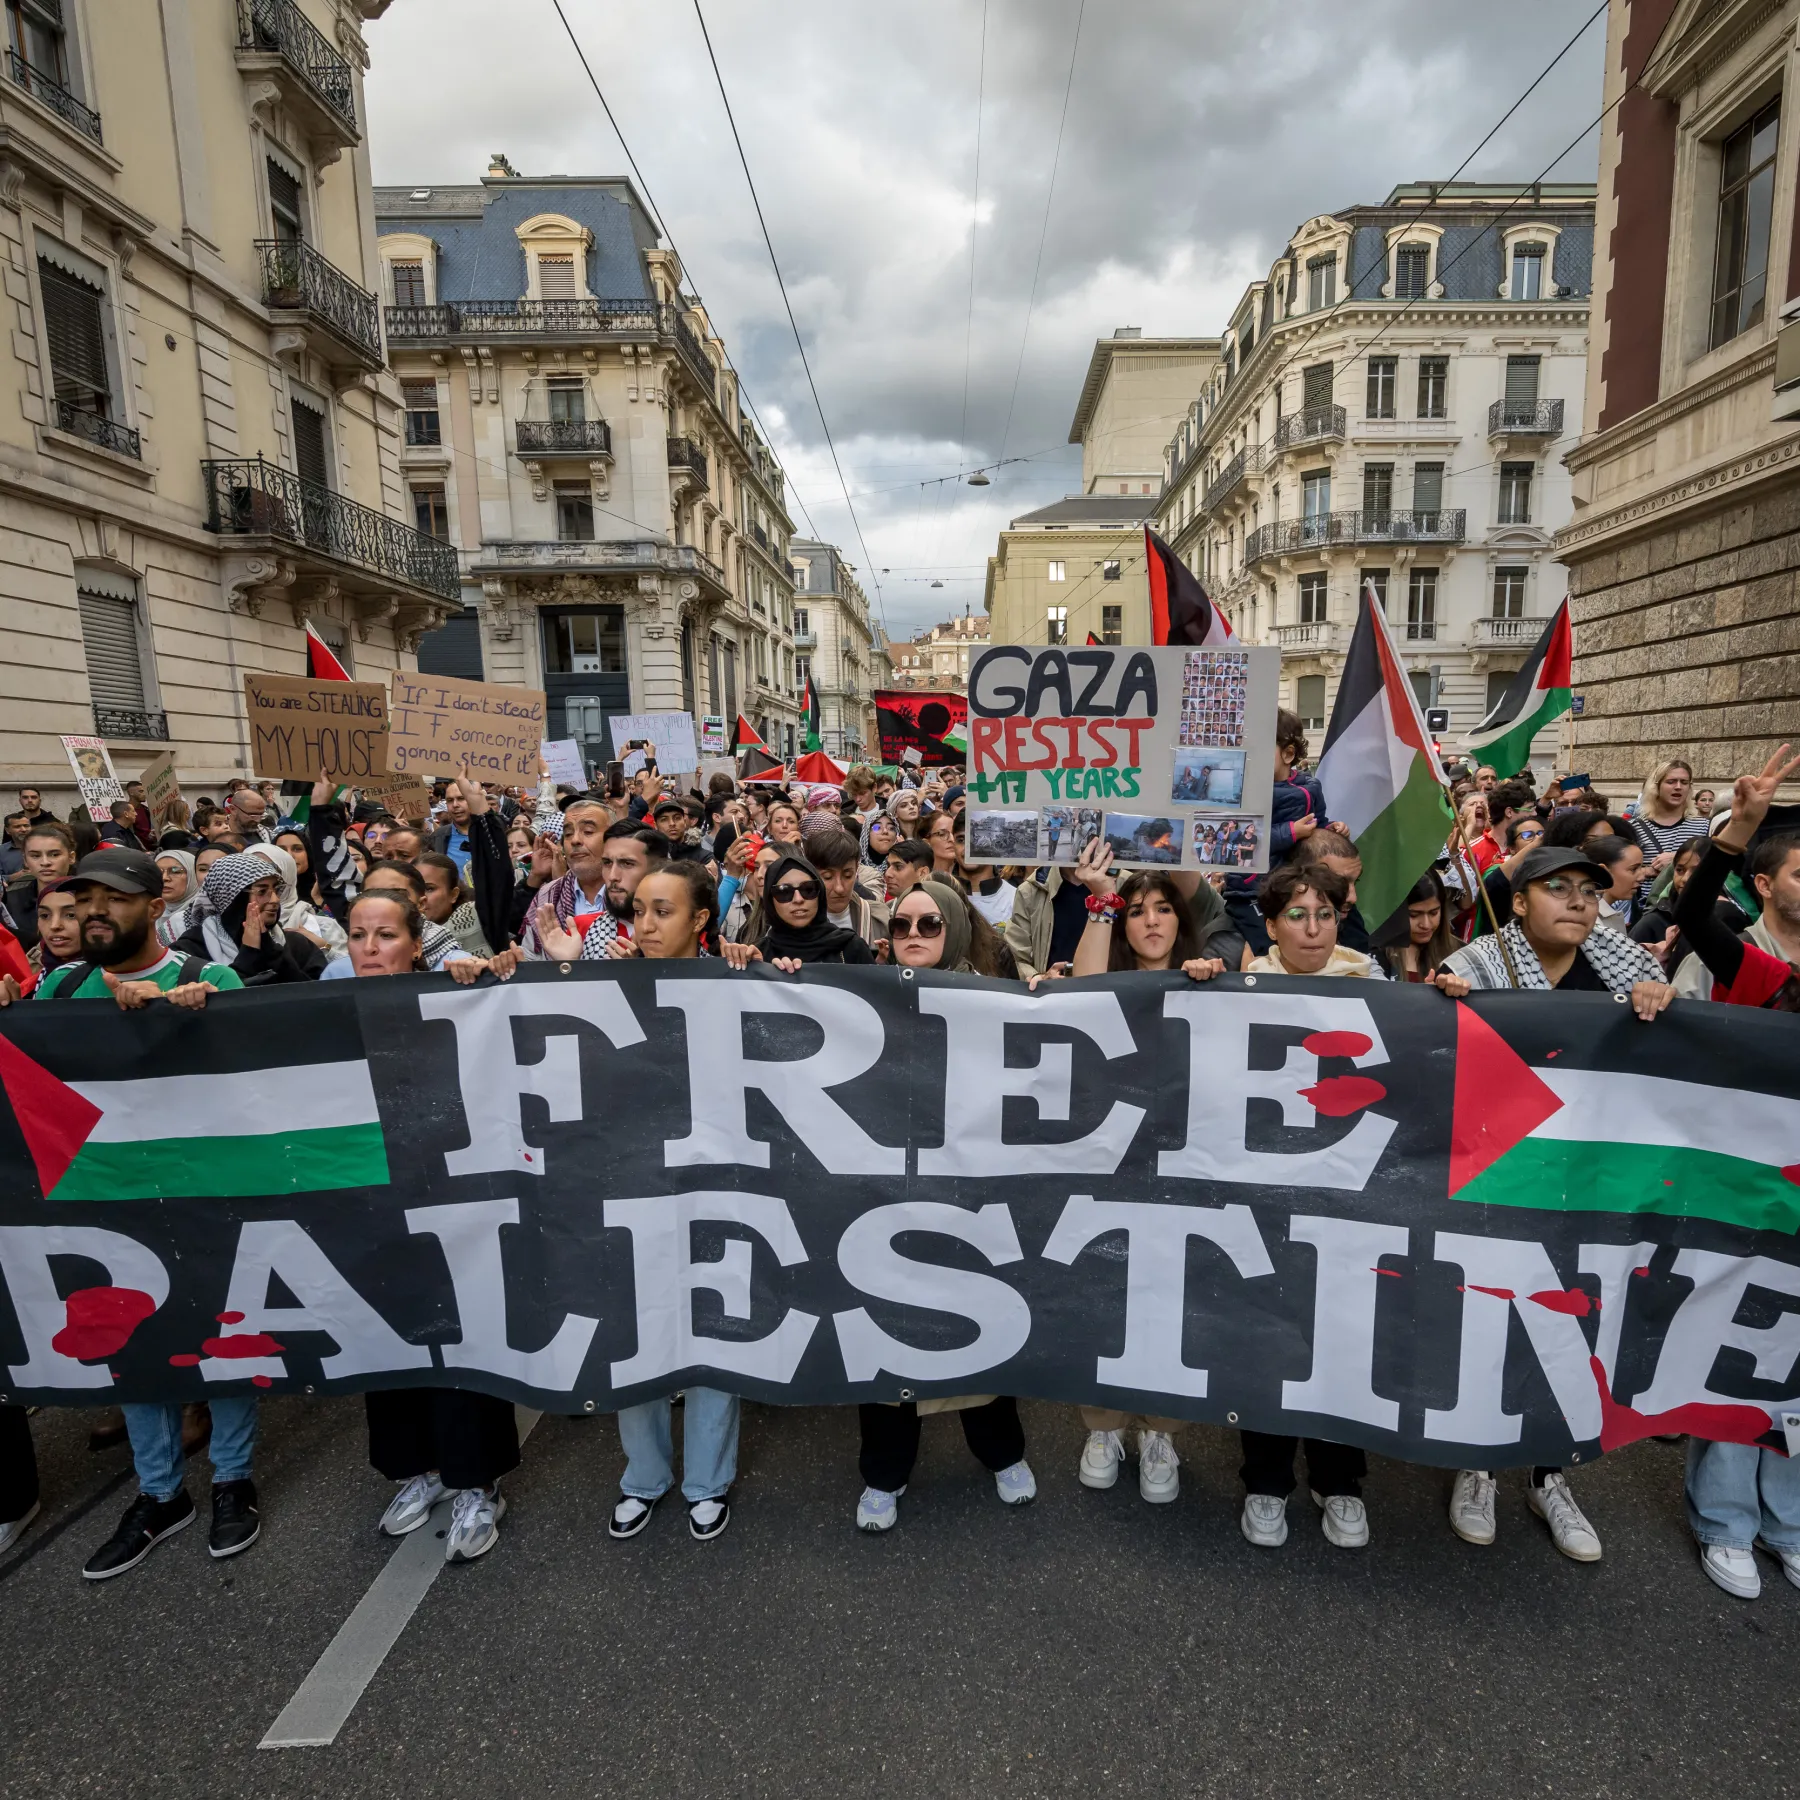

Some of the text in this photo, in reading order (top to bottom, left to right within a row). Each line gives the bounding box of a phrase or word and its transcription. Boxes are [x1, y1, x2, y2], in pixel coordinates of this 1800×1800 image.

[968, 646, 1158, 718] GAZA
[280, 699, 302, 709] are
[435, 689, 450, 708] I
[453, 695, 489, 713] don't
[492, 700, 542, 721] steal
[256, 724, 294, 772] MY
[395, 746, 451, 770] gonna
[972, 716, 1155, 773] RESIST
[79, 779, 120, 790] CAPITALE
[146, 763, 173, 795] PALESTINE
[154, 782, 170, 801] VIVRA
[968, 767, 1142, 804] +17 YEARS
[89, 798, 103, 807] DE
[151, 788, 180, 819] PALESTINE
[381, 793, 404, 805] FREE
[418, 978, 1400, 1191] FREE
[0, 1194, 1800, 1446] PALESTINE
